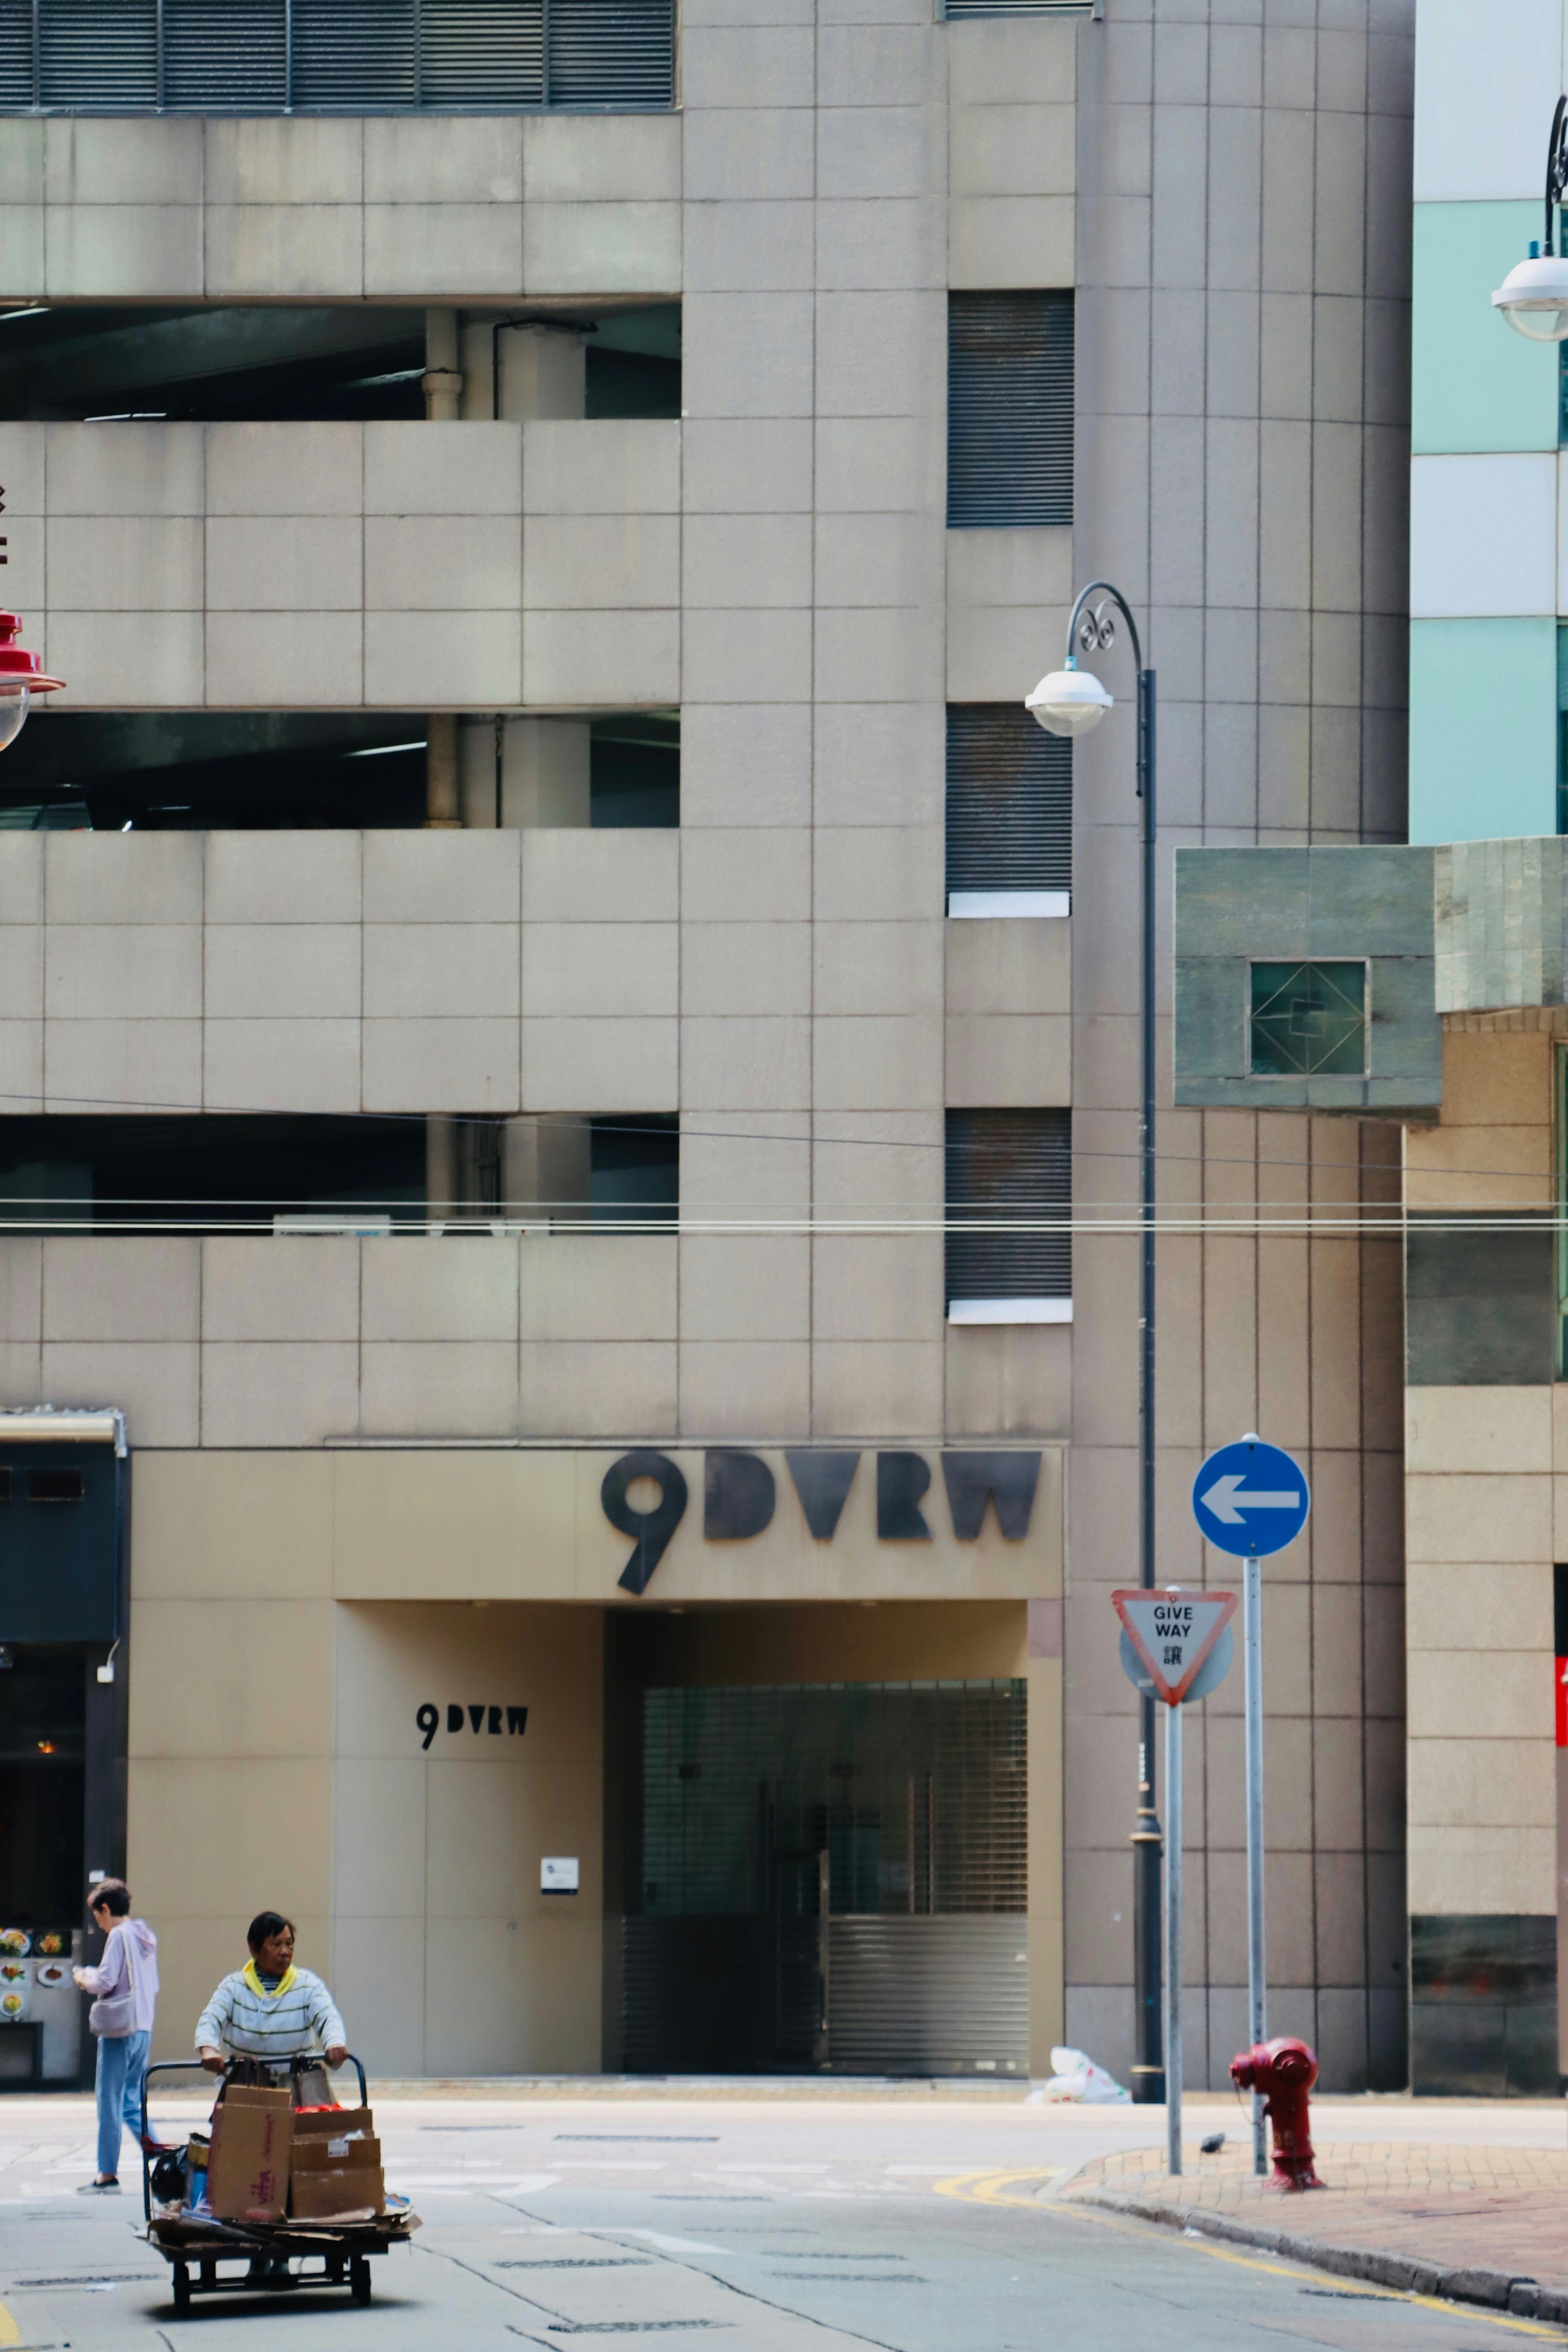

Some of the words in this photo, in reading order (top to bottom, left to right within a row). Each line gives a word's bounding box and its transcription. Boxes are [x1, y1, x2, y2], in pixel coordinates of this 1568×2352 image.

[1154, 1606, 1193, 1620] GIVE
[1156, 1624, 1191, 1637] WAY
[1164, 1646, 1183, 1666] 讓
